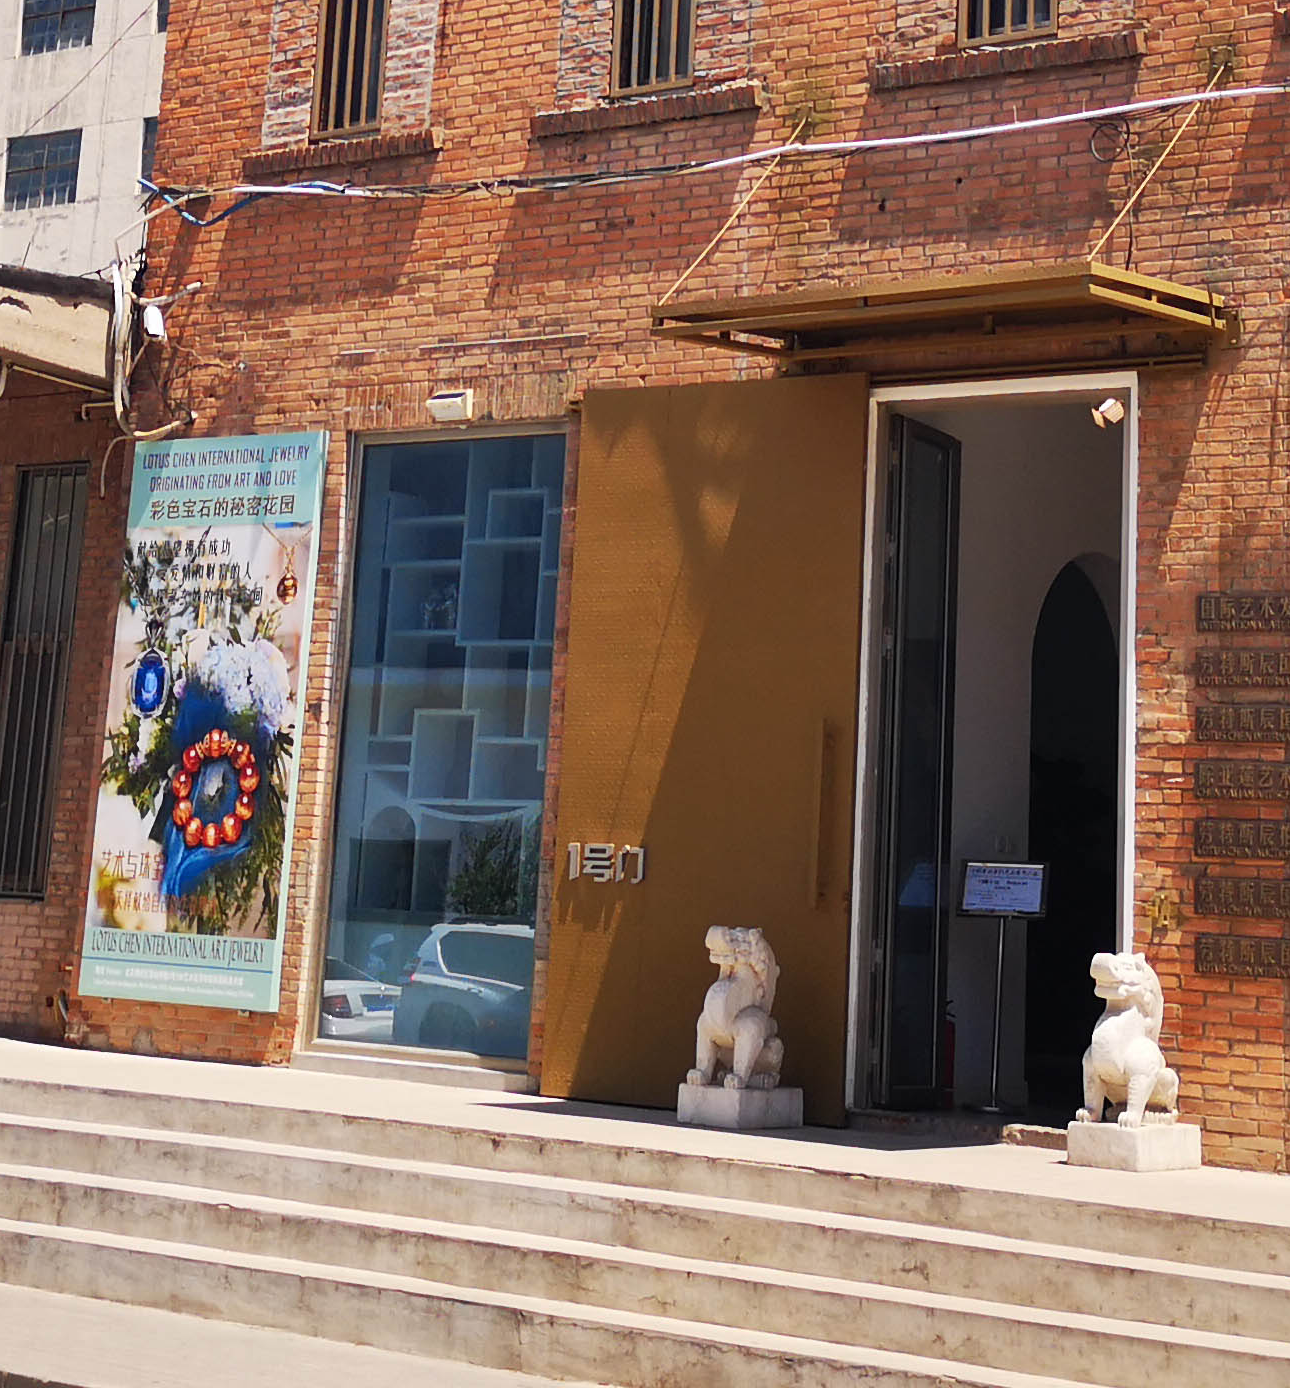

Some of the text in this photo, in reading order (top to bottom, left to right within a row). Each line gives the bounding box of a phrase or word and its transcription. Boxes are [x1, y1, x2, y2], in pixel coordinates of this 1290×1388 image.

[142, 444, 311, 470] LOTUS CHEN INTERNATIONAL JEWELRY
[149, 469, 297, 492] ORIGINATING FROM ART AND LOVE
[150, 494, 296, 521] 彩色宝石的秘密花园
[567, 842, 646, 885] 1号门
[91, 930, 266, 967] LOTUS CHEN INTERNATIONAL ART JEWELRY
